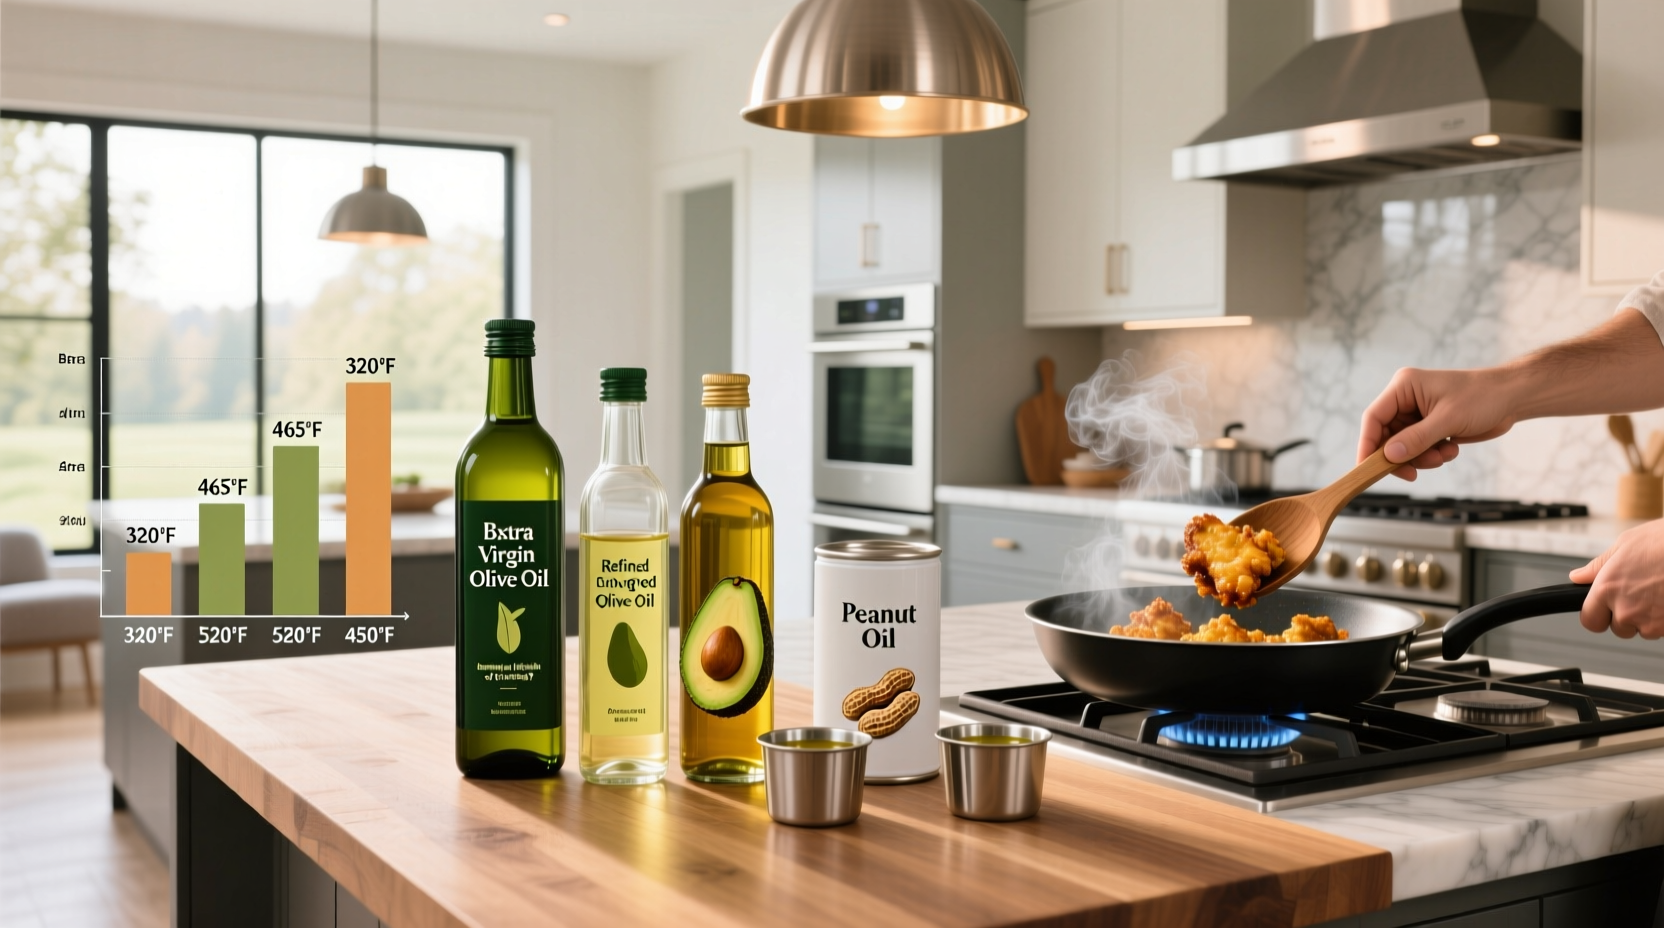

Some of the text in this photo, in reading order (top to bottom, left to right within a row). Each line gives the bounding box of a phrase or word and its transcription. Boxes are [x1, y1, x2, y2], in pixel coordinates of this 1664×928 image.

[478, 545, 535, 569] Virgin
[601, 558, 649, 573] Refined
[469, 569, 550, 588] Olive Oil
[595, 593, 655, 609] Olive Oil
[842, 602, 917, 624] Peanut
[861, 627, 896, 649] Oil
